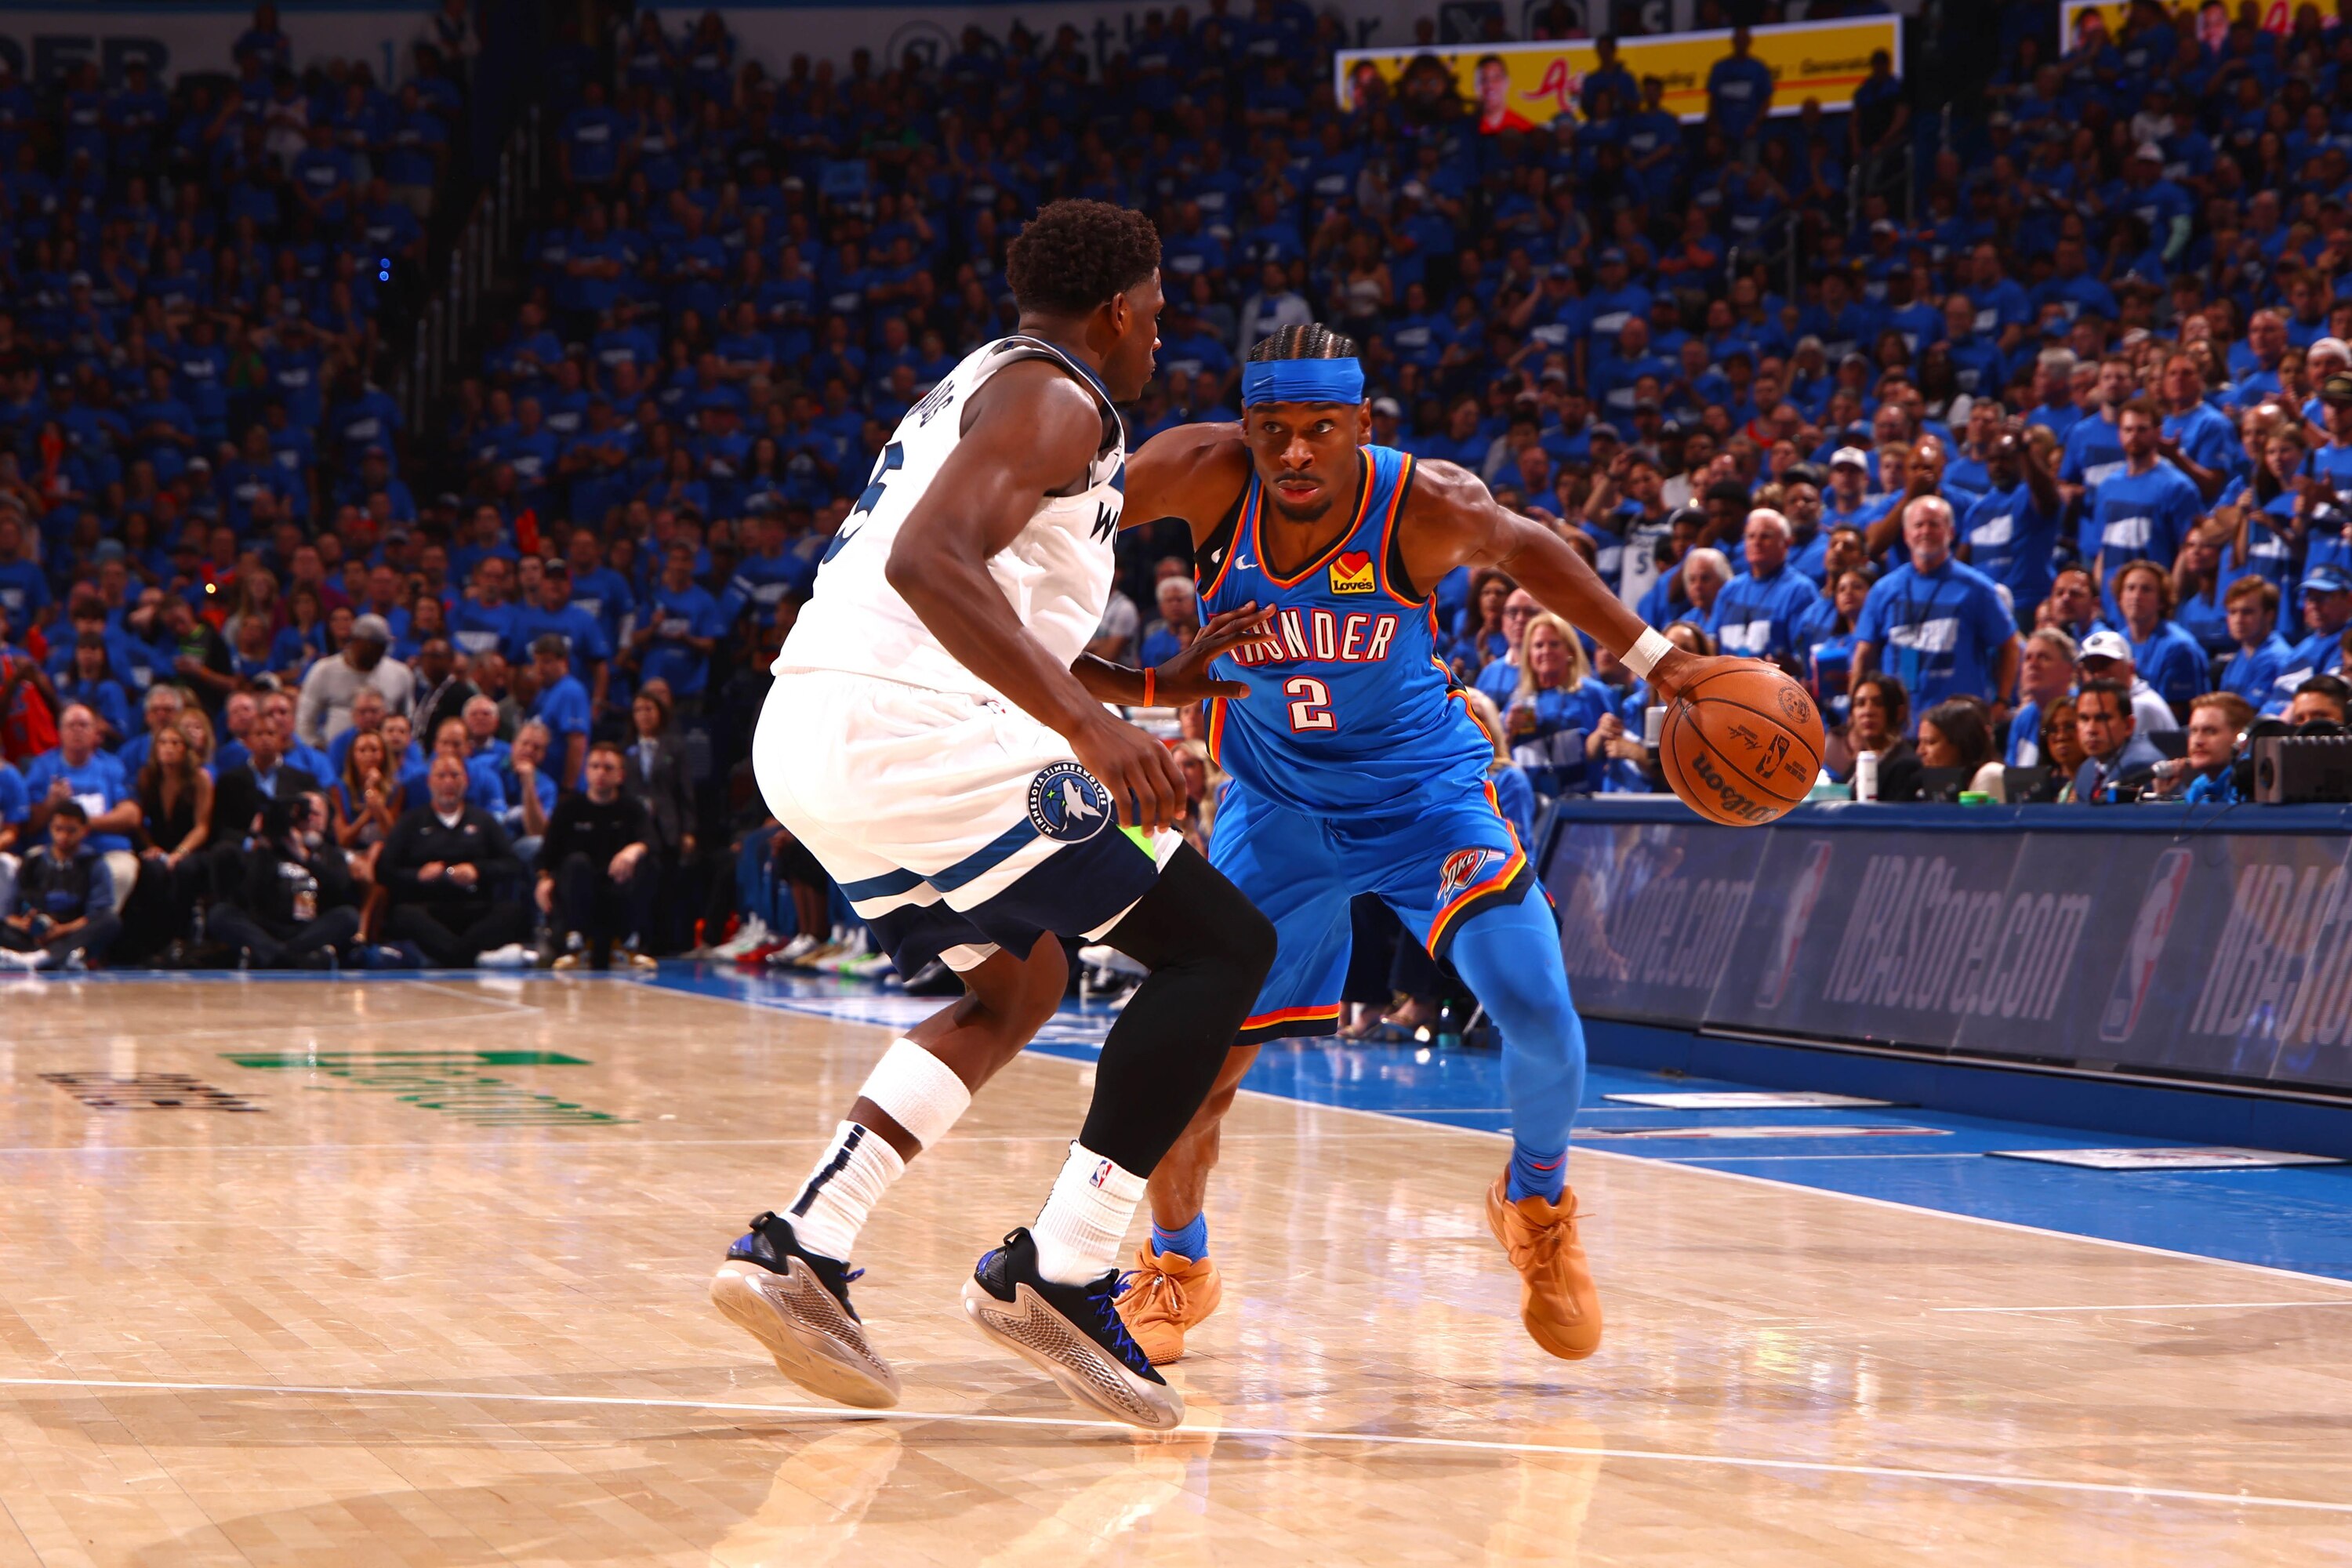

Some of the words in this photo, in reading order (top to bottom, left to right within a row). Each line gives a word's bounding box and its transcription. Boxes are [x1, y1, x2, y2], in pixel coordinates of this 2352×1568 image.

[822, 441, 905, 564] 5
[1635, 551, 1650, 574] 5
[1283, 676, 1337, 734] 2
[1029, 777, 1054, 835] MINNESOTA
[1044, 764, 1108, 806] TIMBERWOLVES
[1692, 751, 1780, 822] Wilson
[1445, 852, 1475, 892] OKC
[1821, 854, 2092, 1021] NBAStore.com
